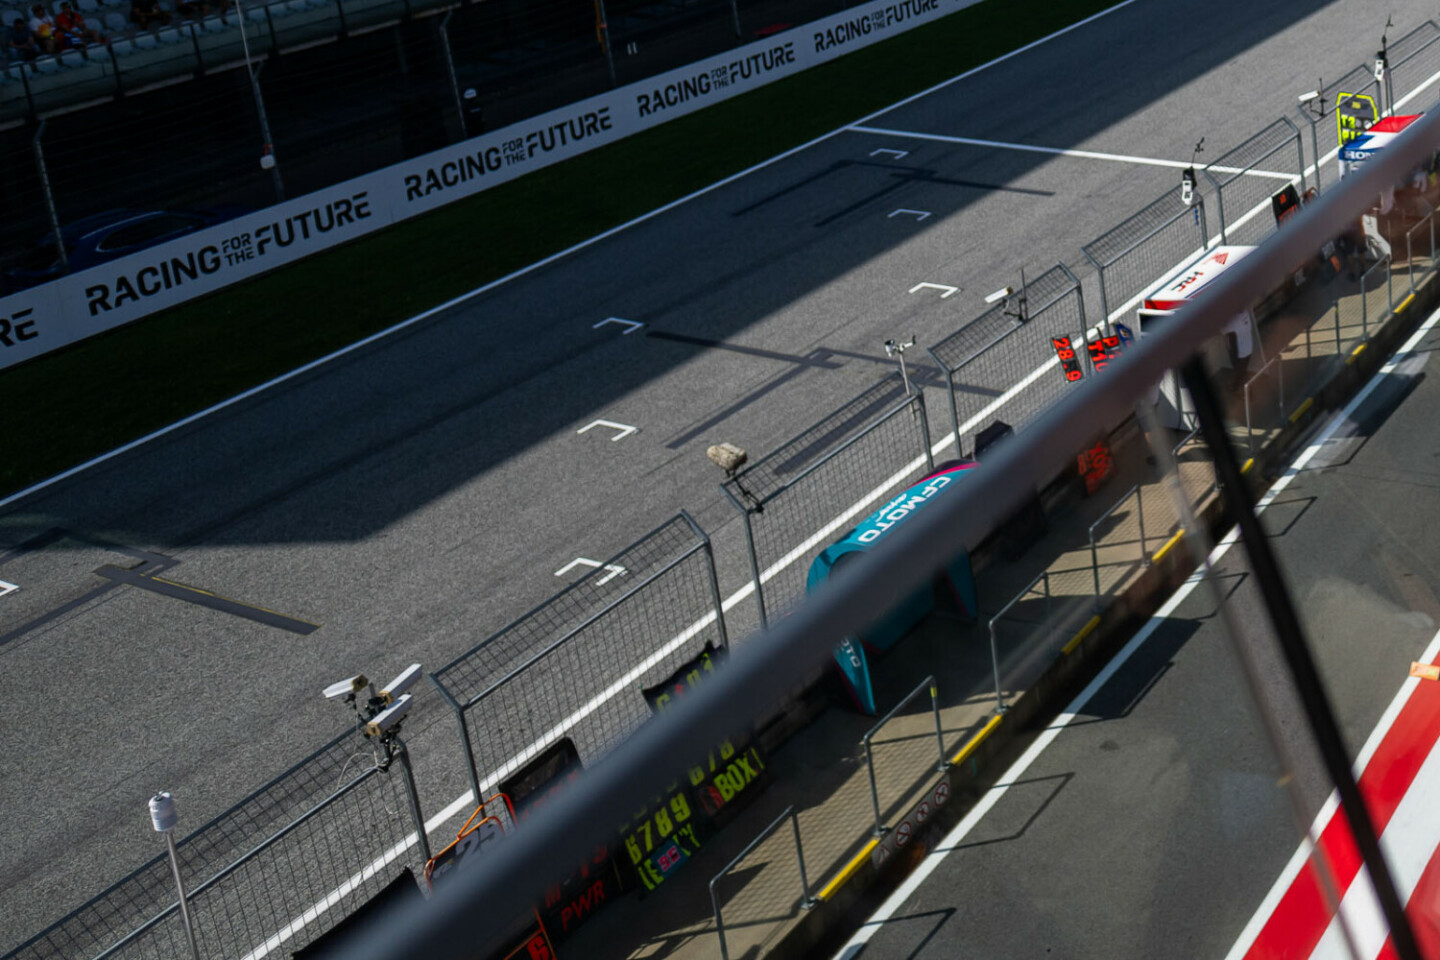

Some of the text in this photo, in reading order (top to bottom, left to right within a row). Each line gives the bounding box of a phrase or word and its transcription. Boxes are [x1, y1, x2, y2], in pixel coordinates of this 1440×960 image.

[814, 15, 872, 53] RACING
[871, 9, 885, 22] FOR
[873, 19, 886, 32] THE
[637, 42, 796, 118] RACING FOR THE FUTURE
[404, 106, 613, 202] RACING FOR THE FUTURE
[85, 191, 372, 317] RACING FOR THE FUTURE
[858, 476, 951, 543] CFMOTO
[560, 880, 607, 934] PWR
